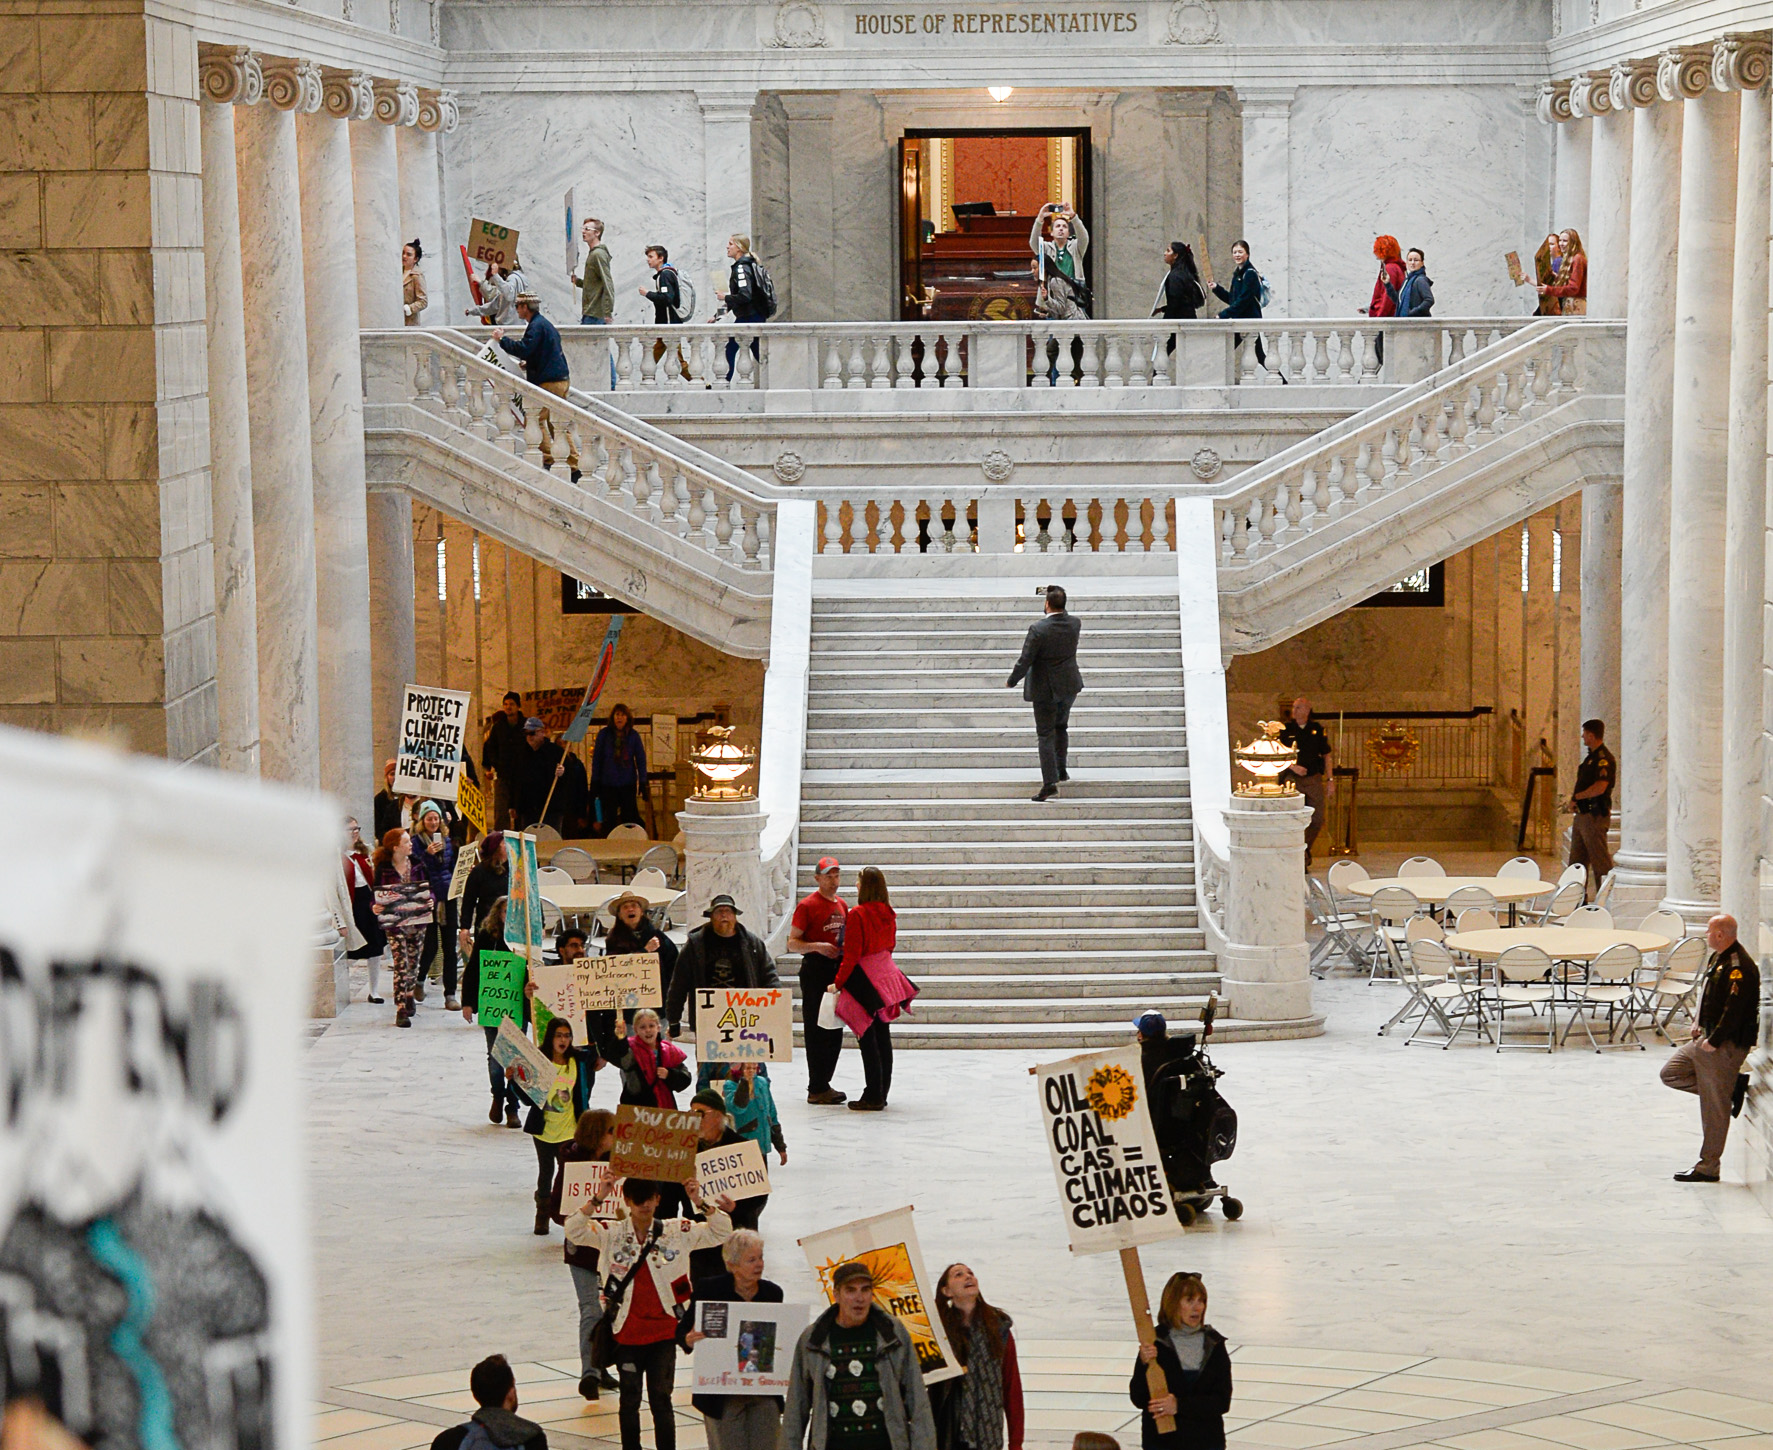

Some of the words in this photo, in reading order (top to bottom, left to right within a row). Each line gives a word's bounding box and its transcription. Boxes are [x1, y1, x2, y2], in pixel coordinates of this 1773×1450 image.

[855, 15, 916, 34] HOUSE
[923, 15, 946, 34] OF
[952, 12, 1138, 33] REPRESENTATIVES
[482, 221, 509, 240] ECO
[476, 245, 505, 264] EGO
[526, 689, 557, 701] KEEP
[561, 687, 585, 698] OUR
[407, 692, 463, 719] PROTECT
[421, 713, 444, 723] OUR
[405, 718, 461, 745] CLIMATE
[404, 737, 456, 761] WATER
[414, 755, 439, 764] AND
[399, 758, 455, 784] HEALTH
[460, 780, 483, 812] WILD
[460, 796, 484, 828] UTAH
[609, 956, 616, 968] I
[636, 956, 659, 965] clean
[487, 971, 499, 980] BE
[504, 972, 511, 982] A
[576, 974, 590, 985] my
[641, 969, 651, 980] I
[481, 986, 520, 1002] FOSSIL
[579, 987, 600, 997] have
[604, 985, 615, 996] to
[639, 983, 657, 995] the
[697, 989, 716, 1009] I
[725, 988, 782, 1008] Want
[484, 1006, 515, 1019] FOOL
[717, 1007, 760, 1029] Air
[720, 1029, 735, 1043] I
[633, 1106, 663, 1127] YOU
[666, 1113, 702, 1130] CAN
[615, 1140, 634, 1155] BUT
[642, 1144, 662, 1158] YOU
[701, 1153, 744, 1177] RESIST
[1060, 1147, 1115, 1177] GAS
[568, 1183, 579, 1197] IS
[699, 1169, 765, 1198] XTINCTION
[1065, 1164, 1162, 1205] CLIMATE
[1072, 1191, 1168, 1229] CHAOS
[889, 1294, 922, 1317] FREE
